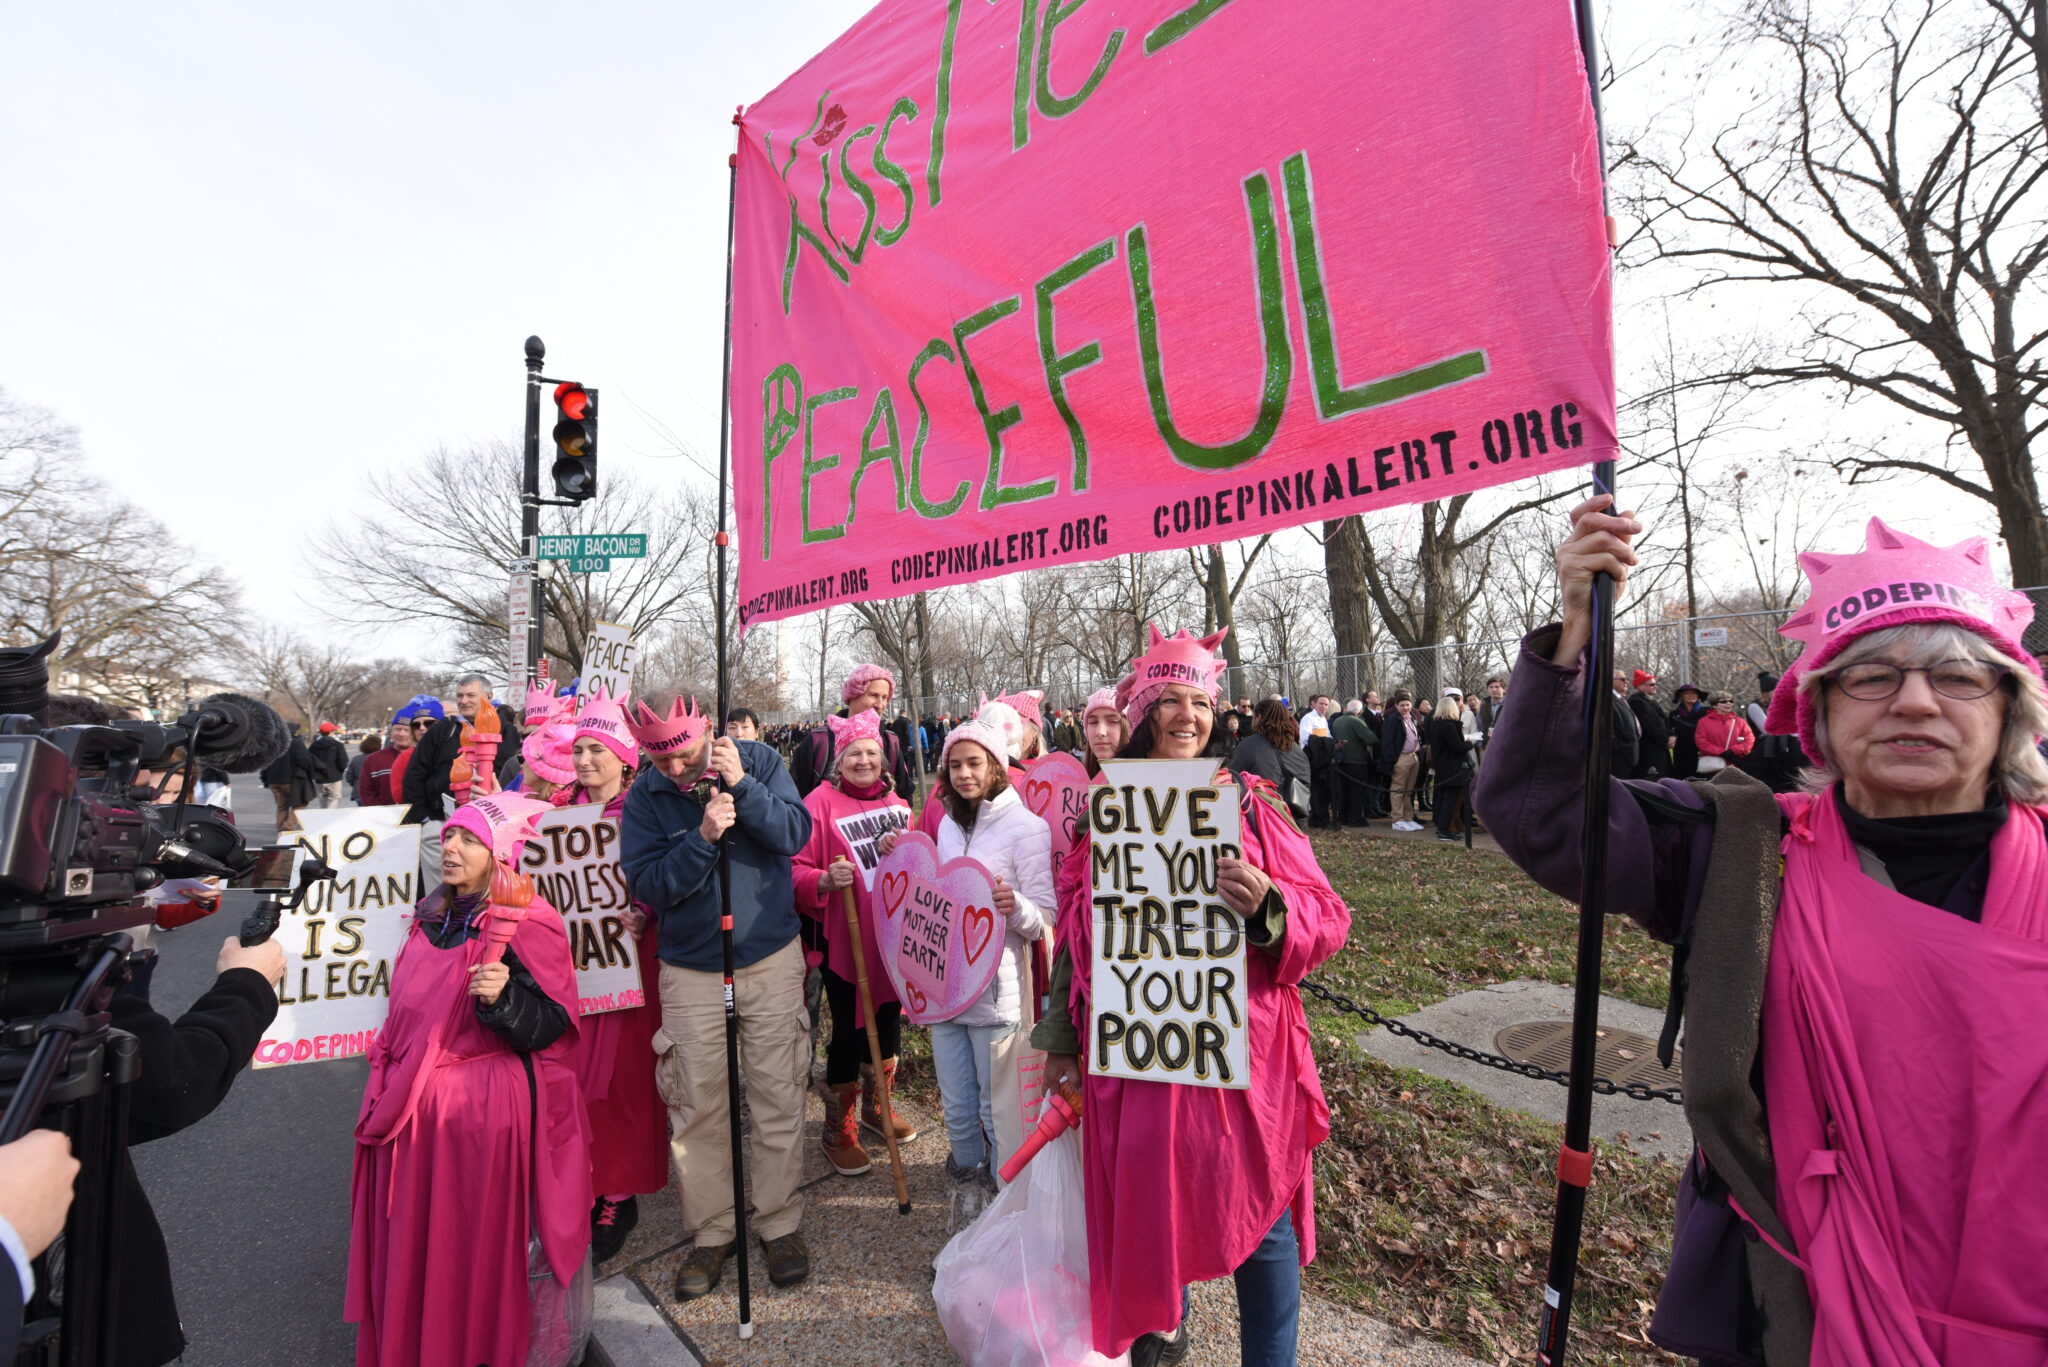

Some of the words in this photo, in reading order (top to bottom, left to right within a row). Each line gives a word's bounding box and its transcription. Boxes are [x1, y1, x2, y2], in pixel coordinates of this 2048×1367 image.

[761, 149, 1488, 561] PEACEFUL
[1153, 402, 1584, 539] CODEPINKALERT.ORG
[540, 538, 580, 556] HENRY
[585, 537, 628, 556] BACON
[577, 558, 604, 571] 100
[628, 547, 641, 555] NW
[629, 538, 641, 546] DR
[891, 514, 1108, 585] CODEPINKALERT.ORG
[738, 566, 869, 627] CODEPINKALERT.ORG
[585, 635, 635, 674] PEACE
[1147, 662, 1209, 688] CODEPINK
[589, 674, 616, 700] ON
[1091, 784, 1220, 840] GIVE
[296, 831, 377, 864] NO
[523, 821, 618, 868] STOP
[1091, 841, 1149, 895] ME
[285, 872, 414, 916] UMAN
[530, 860, 630, 917] NDLESS
[914, 886, 953, 922] LOVE
[301, 914, 368, 961] IS
[903, 907, 948, 952] MOTHER
[1092, 893, 1245, 963] TIRED
[902, 935, 946, 981] EARTH
[278, 958, 390, 1006] LLEGA
[1110, 965, 1242, 1028] YOUR
[1097, 1010, 1235, 1083] POOR
